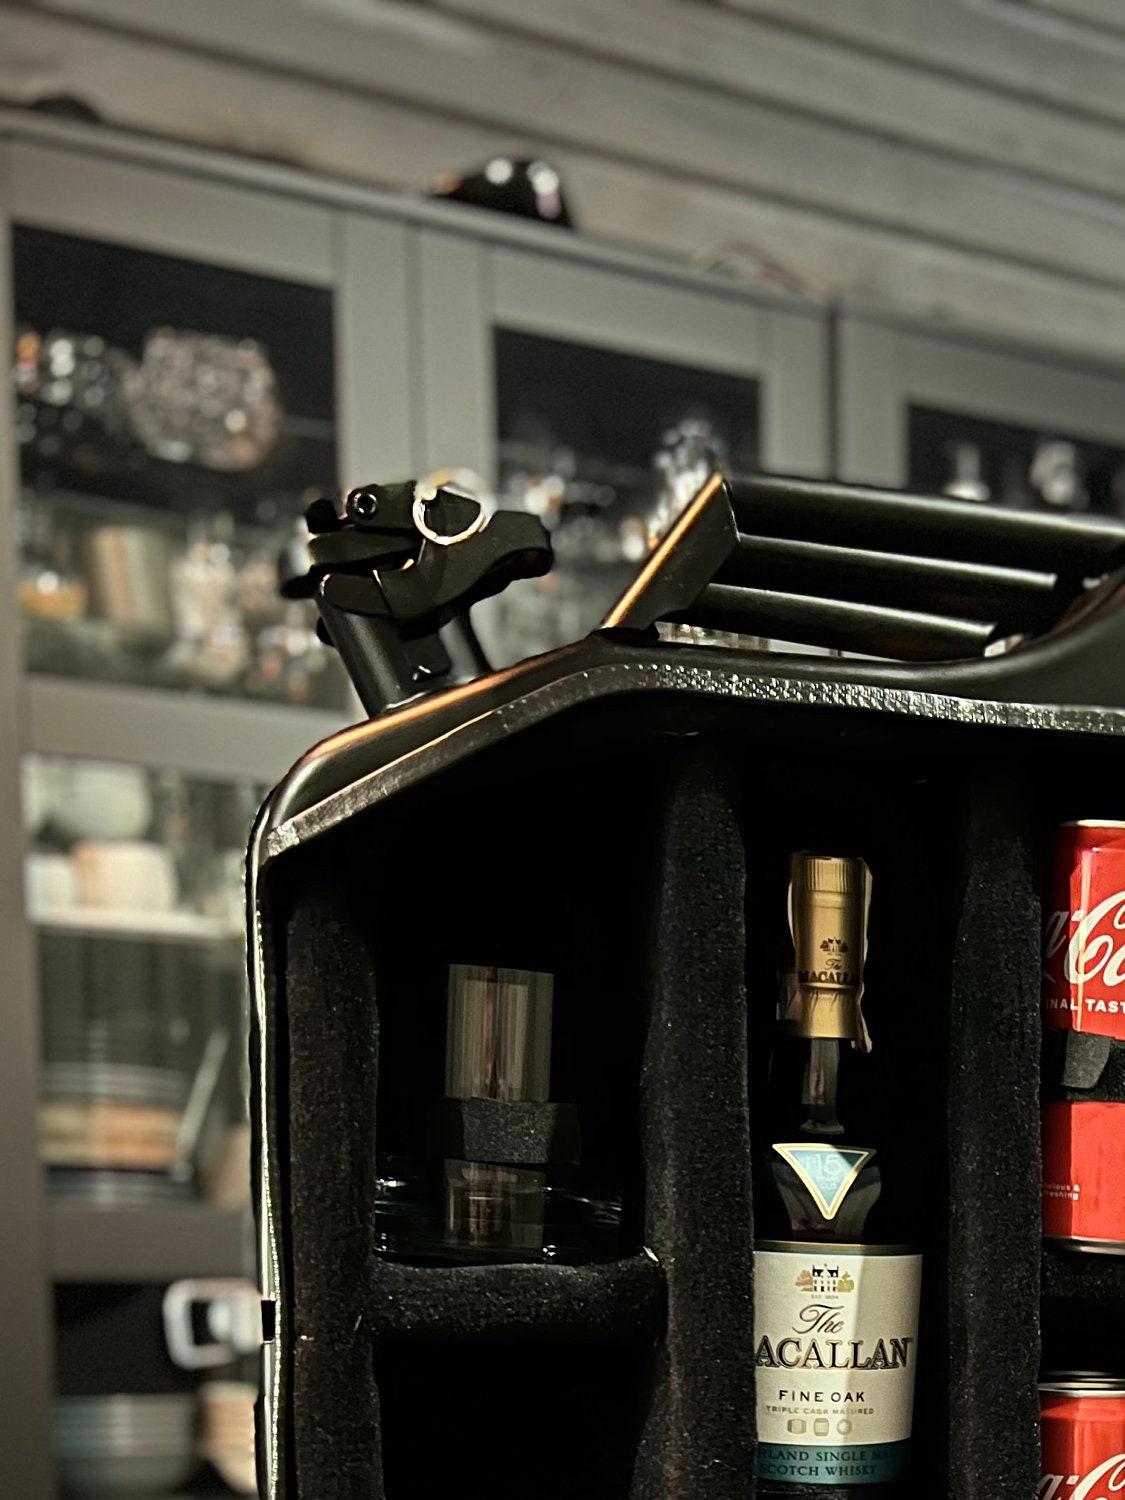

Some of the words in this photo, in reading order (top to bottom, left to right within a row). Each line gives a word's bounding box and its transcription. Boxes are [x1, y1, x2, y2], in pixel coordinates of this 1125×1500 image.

[815, 1154, 842, 1175] 15
[792, 1304, 845, 1334] The
[755, 1335, 913, 1370] ACALLAN
[779, 1390, 824, 1402] FINE
[830, 1391, 865, 1402] OAK
[765, 1405, 800, 1414] TRIPLE
[803, 1407, 829, 1415] CASK
[832, 1407, 875, 1415] MATURED
[757, 1449, 810, 1461] HLAND
[816, 1450, 868, 1462] SINGLE
[759, 1463, 819, 1476] SCOTCH
[825, 1463, 877, 1476] WHISKY
